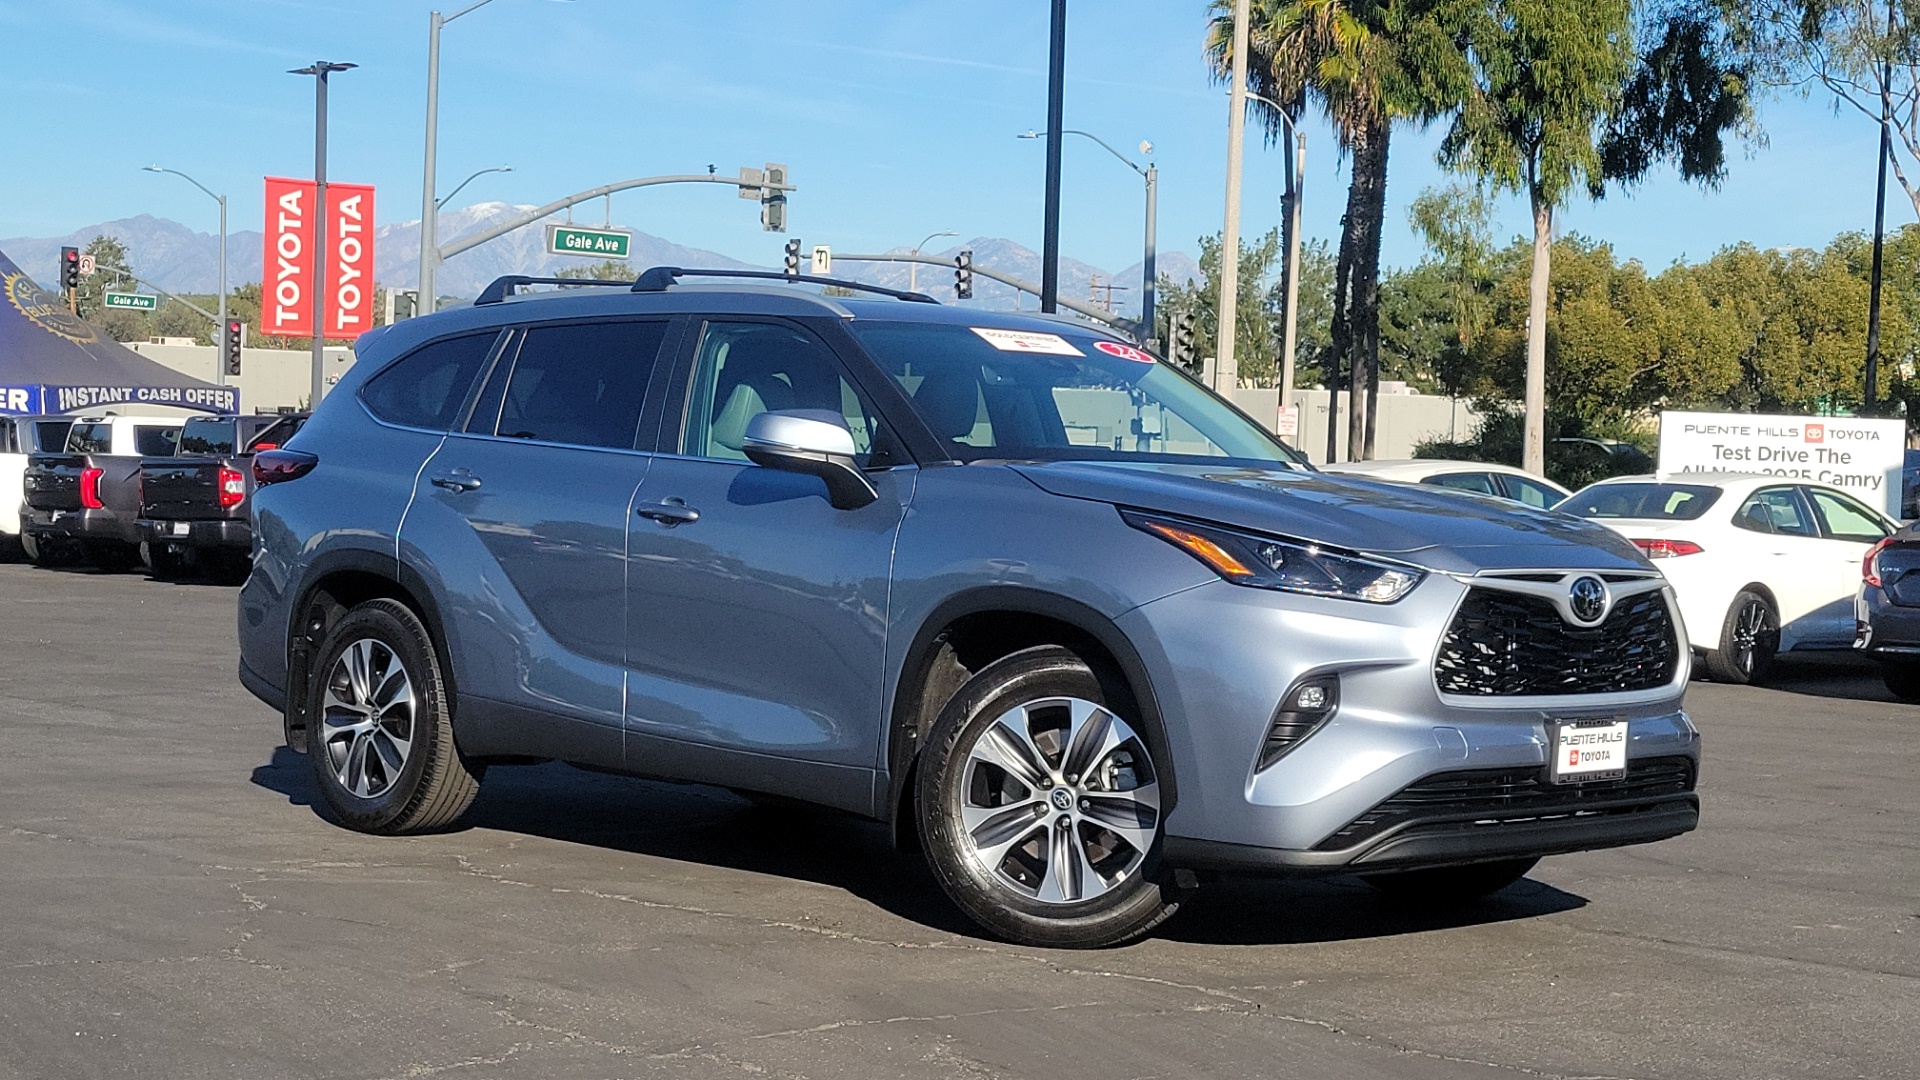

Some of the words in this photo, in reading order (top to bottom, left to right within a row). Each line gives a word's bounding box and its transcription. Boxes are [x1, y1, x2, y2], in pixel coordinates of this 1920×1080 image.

[565, 234, 593, 249] Gale
[594, 236, 619, 251] Ave
[276, 189, 303, 326] TOYOTA
[337, 194, 362, 330] TOYOTA
[113, 296, 131, 305] Gale
[132, 297, 149, 306] Ave
[58, 387, 133, 411] INSTANT
[137, 388, 182, 402] CASH
[185, 388, 235, 411] OFFER
[1684, 424, 1751, 435] PUENTE
[1757, 427, 1799, 437] HILLS
[1829, 429, 1880, 441] TOYOTA
[1712, 445, 1751, 461] Test
[1757, 446, 1809, 463] Drive
[1815, 448, 1852, 465] The
[1818, 470, 1883, 491] Camry
[1559, 734, 1597, 746] PUENTE
[1597, 731, 1623, 744] HILLS
[1581, 750, 1611, 762] TOYOTA
